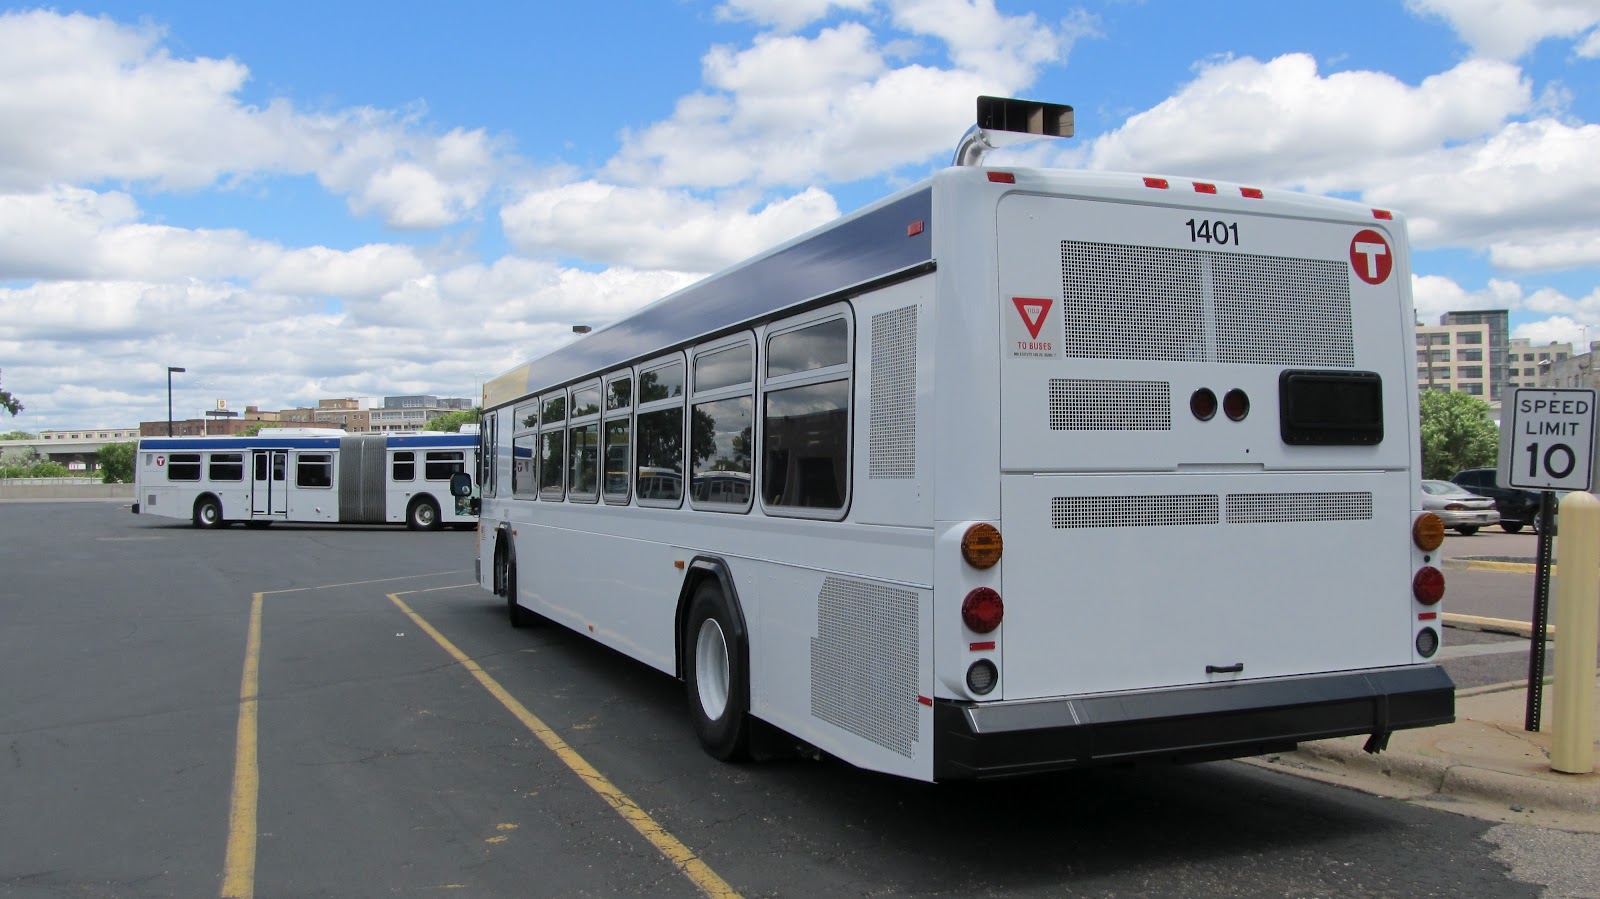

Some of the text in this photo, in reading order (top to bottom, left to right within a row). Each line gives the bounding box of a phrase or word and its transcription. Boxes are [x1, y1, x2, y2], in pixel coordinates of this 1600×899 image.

[1185, 218, 1239, 246] 1401
[1354, 241, 1387, 279] T
[1017, 341, 1052, 351] TO BUSES
[1520, 399, 1589, 415] SPEED
[1526, 421, 1580, 437] LIMIT
[1526, 442, 1576, 479] 10
